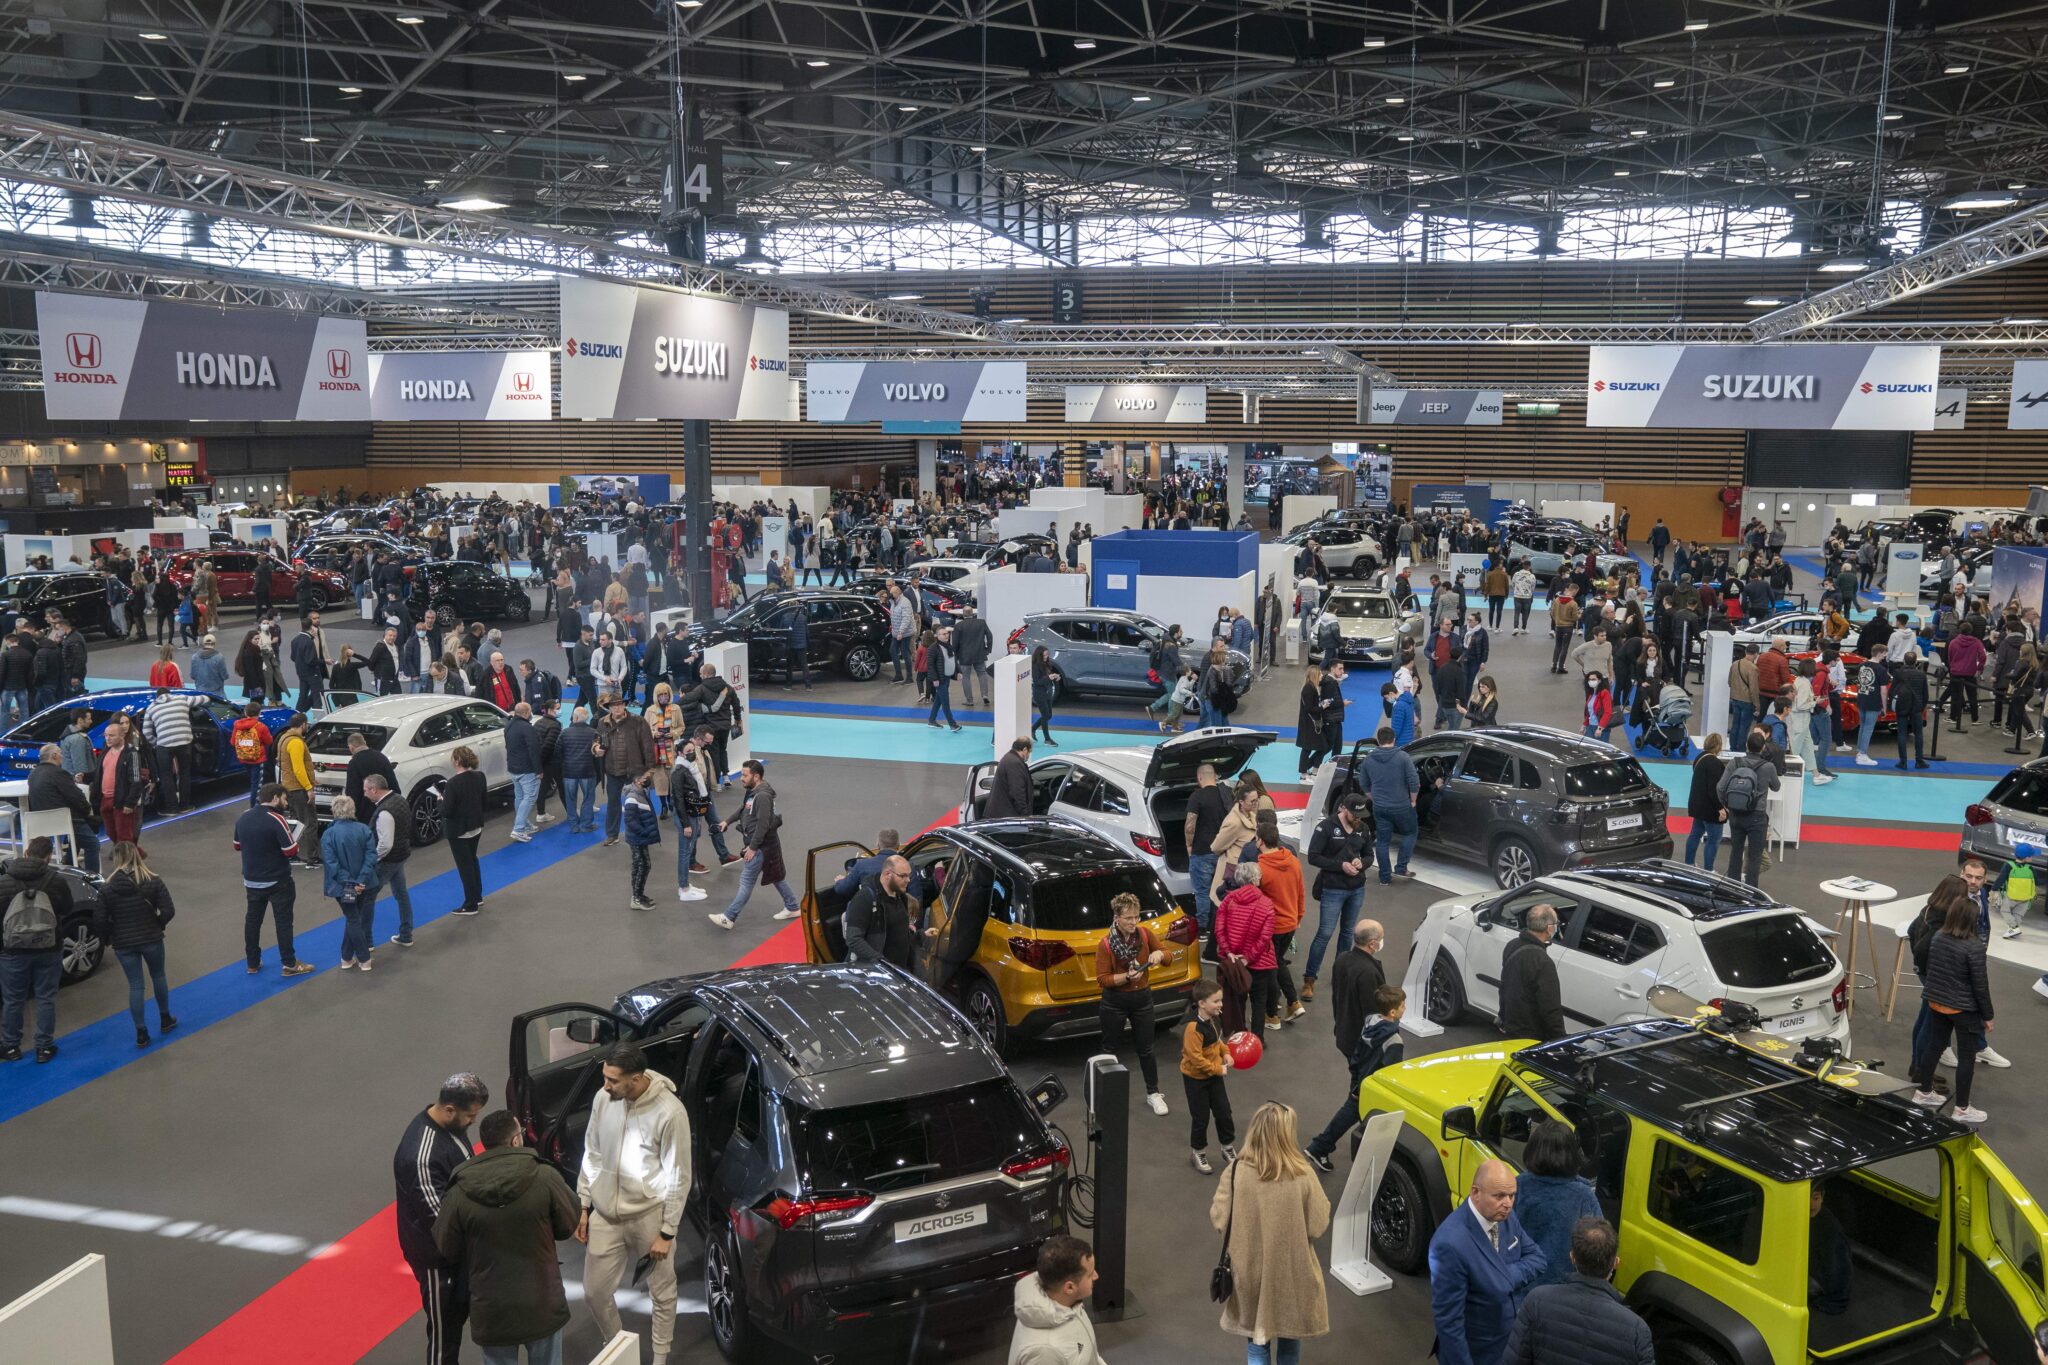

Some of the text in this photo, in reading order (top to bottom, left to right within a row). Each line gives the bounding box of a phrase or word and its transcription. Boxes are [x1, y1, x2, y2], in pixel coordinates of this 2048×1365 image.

[687, 145, 708, 154] HALL
[685, 164, 712, 203] 4
[1061, 289, 1074, 310] 3
[580, 342, 622, 359] SUZUKI
[655, 335, 725, 376] SUZUKI
[176, 351, 276, 387] HONDA
[758, 358, 787, 372] SUZUKI
[54, 372, 118, 385] HONDA
[319, 381, 361, 391] HONDA
[400, 379, 471, 400] HONDA
[882, 383, 945, 401] VOLVO
[1608, 382, 1660, 391] SUZUKI
[1702, 374, 1815, 399] SUZUKI
[1877, 383, 1932, 393] SUZUKI
[1115, 398, 1156, 410] VOLVO
[1373, 403, 1396, 412] Jeep
[1419, 403, 1450, 414] JEEP
[1476, 404, 1500, 413] Jeep
[169, 476, 194, 485] VERT
[1457, 566, 1481, 575] Jeep
[1780, 1015, 1805, 1029] IGNIS
[909, 1210, 975, 1235] ACROSS
